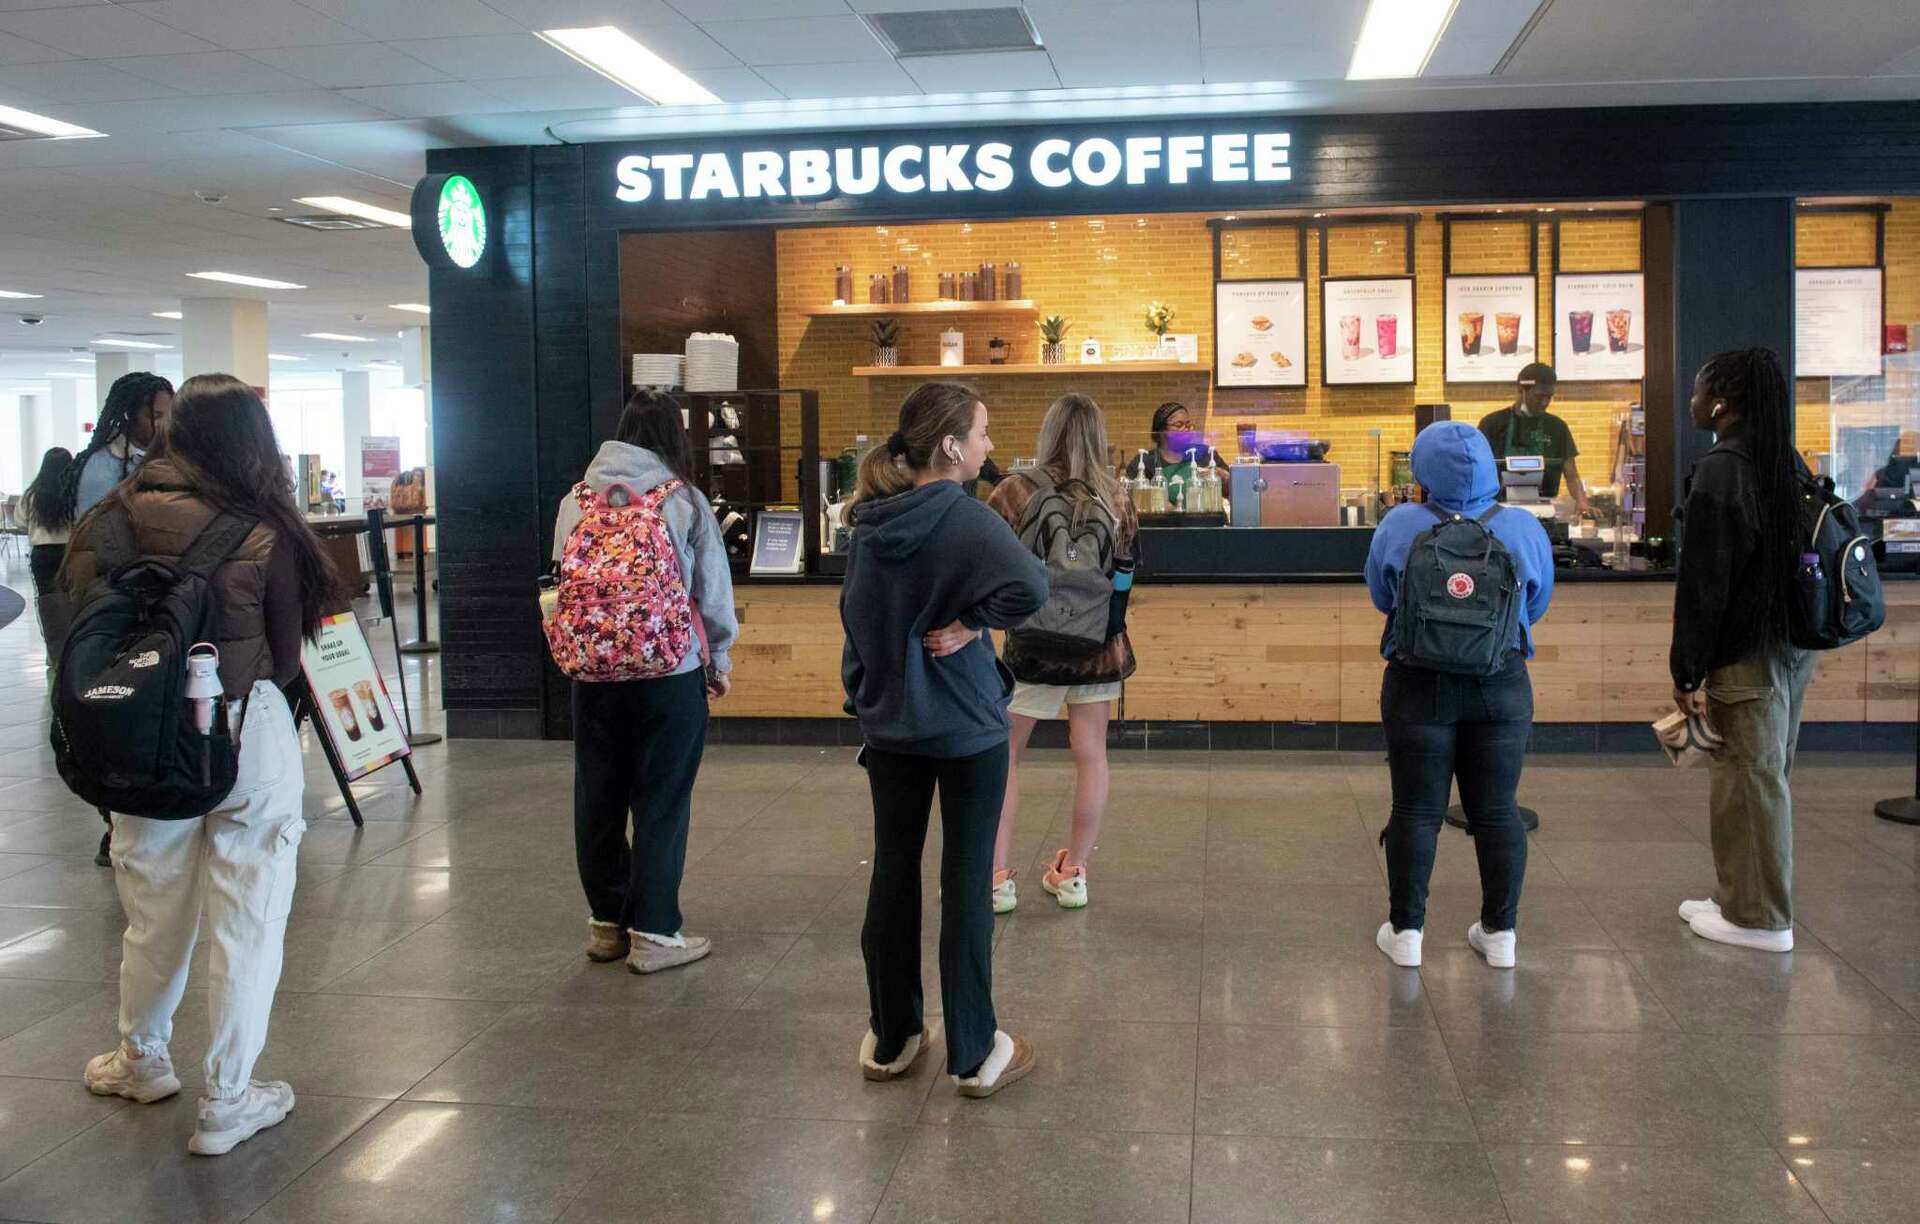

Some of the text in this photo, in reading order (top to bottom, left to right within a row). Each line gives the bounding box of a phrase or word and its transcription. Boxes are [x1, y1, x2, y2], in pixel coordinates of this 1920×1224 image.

[615, 132, 1292, 202] STARBUCKS COFFEE
[84, 685, 135, 698] JAMESON
